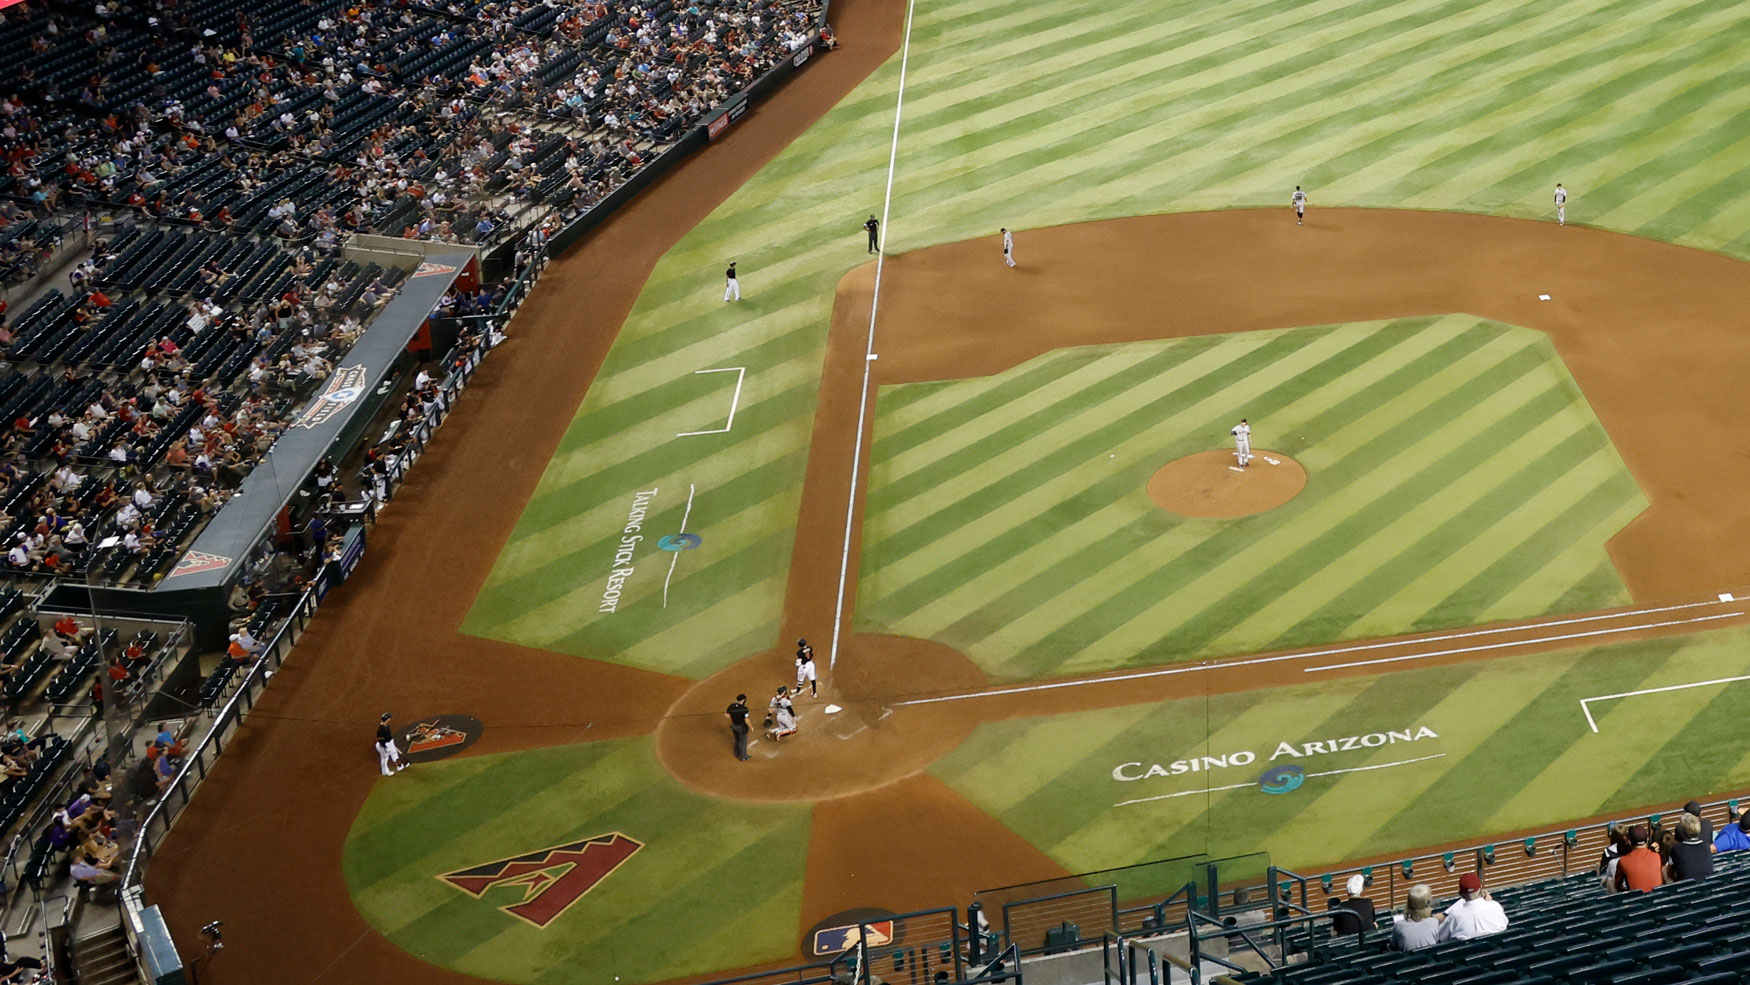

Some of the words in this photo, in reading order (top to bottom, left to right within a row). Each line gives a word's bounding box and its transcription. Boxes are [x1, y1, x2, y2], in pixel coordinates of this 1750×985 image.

[624, 487, 658, 534] TALKING
[612, 535, 644, 568] STICK
[598, 567, 634, 614] RESORT
[1112, 750, 1256, 782] CASINO
[1268, 726, 1440, 761] ARIZONA
